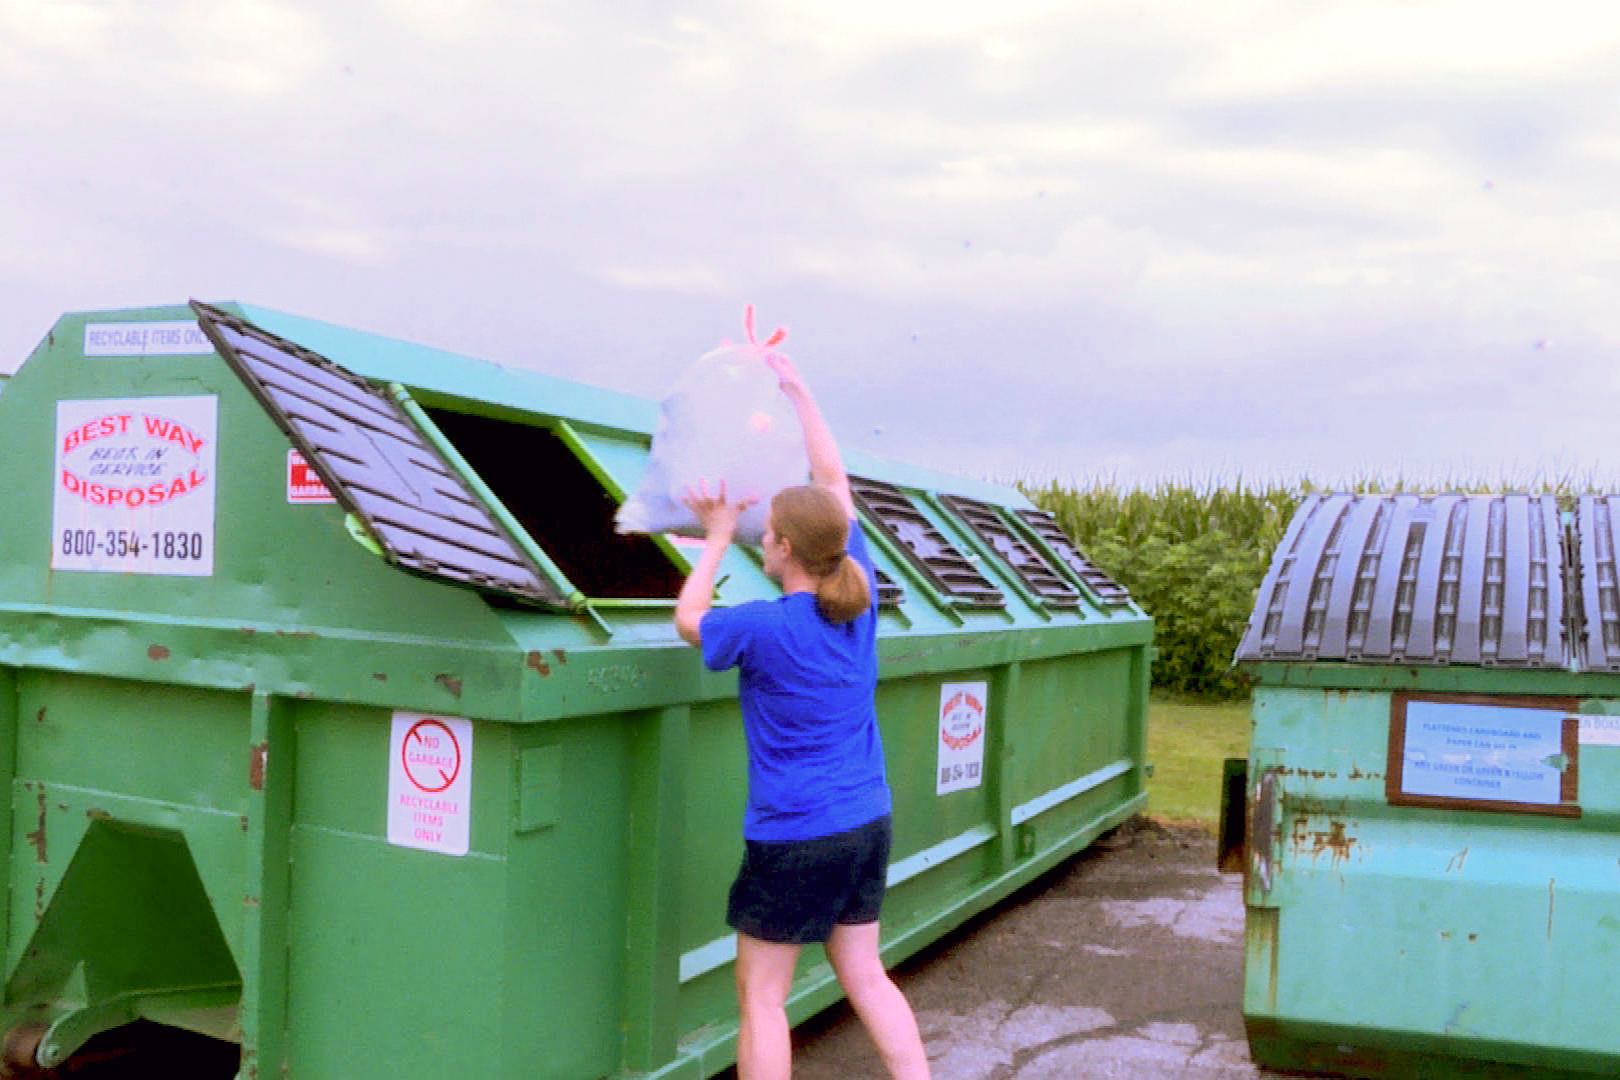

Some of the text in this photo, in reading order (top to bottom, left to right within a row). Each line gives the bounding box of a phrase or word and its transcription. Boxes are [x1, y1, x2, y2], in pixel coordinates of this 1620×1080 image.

[89, 330, 148, 346] RECYCLABLE
[152, 329, 181, 345] ITEMS
[63, 415, 203, 453] BEST WAY
[62, 470, 206, 508] DISPOSAL
[62, 529, 202, 561] 800-354-1830
[424, 735, 440, 749] NO
[408, 751, 454, 769] GARBAGE
[400, 793, 458, 815] RECYCLABLE
[413, 811, 444, 827] ITEMS
[414, 827, 442, 843] ONLY
